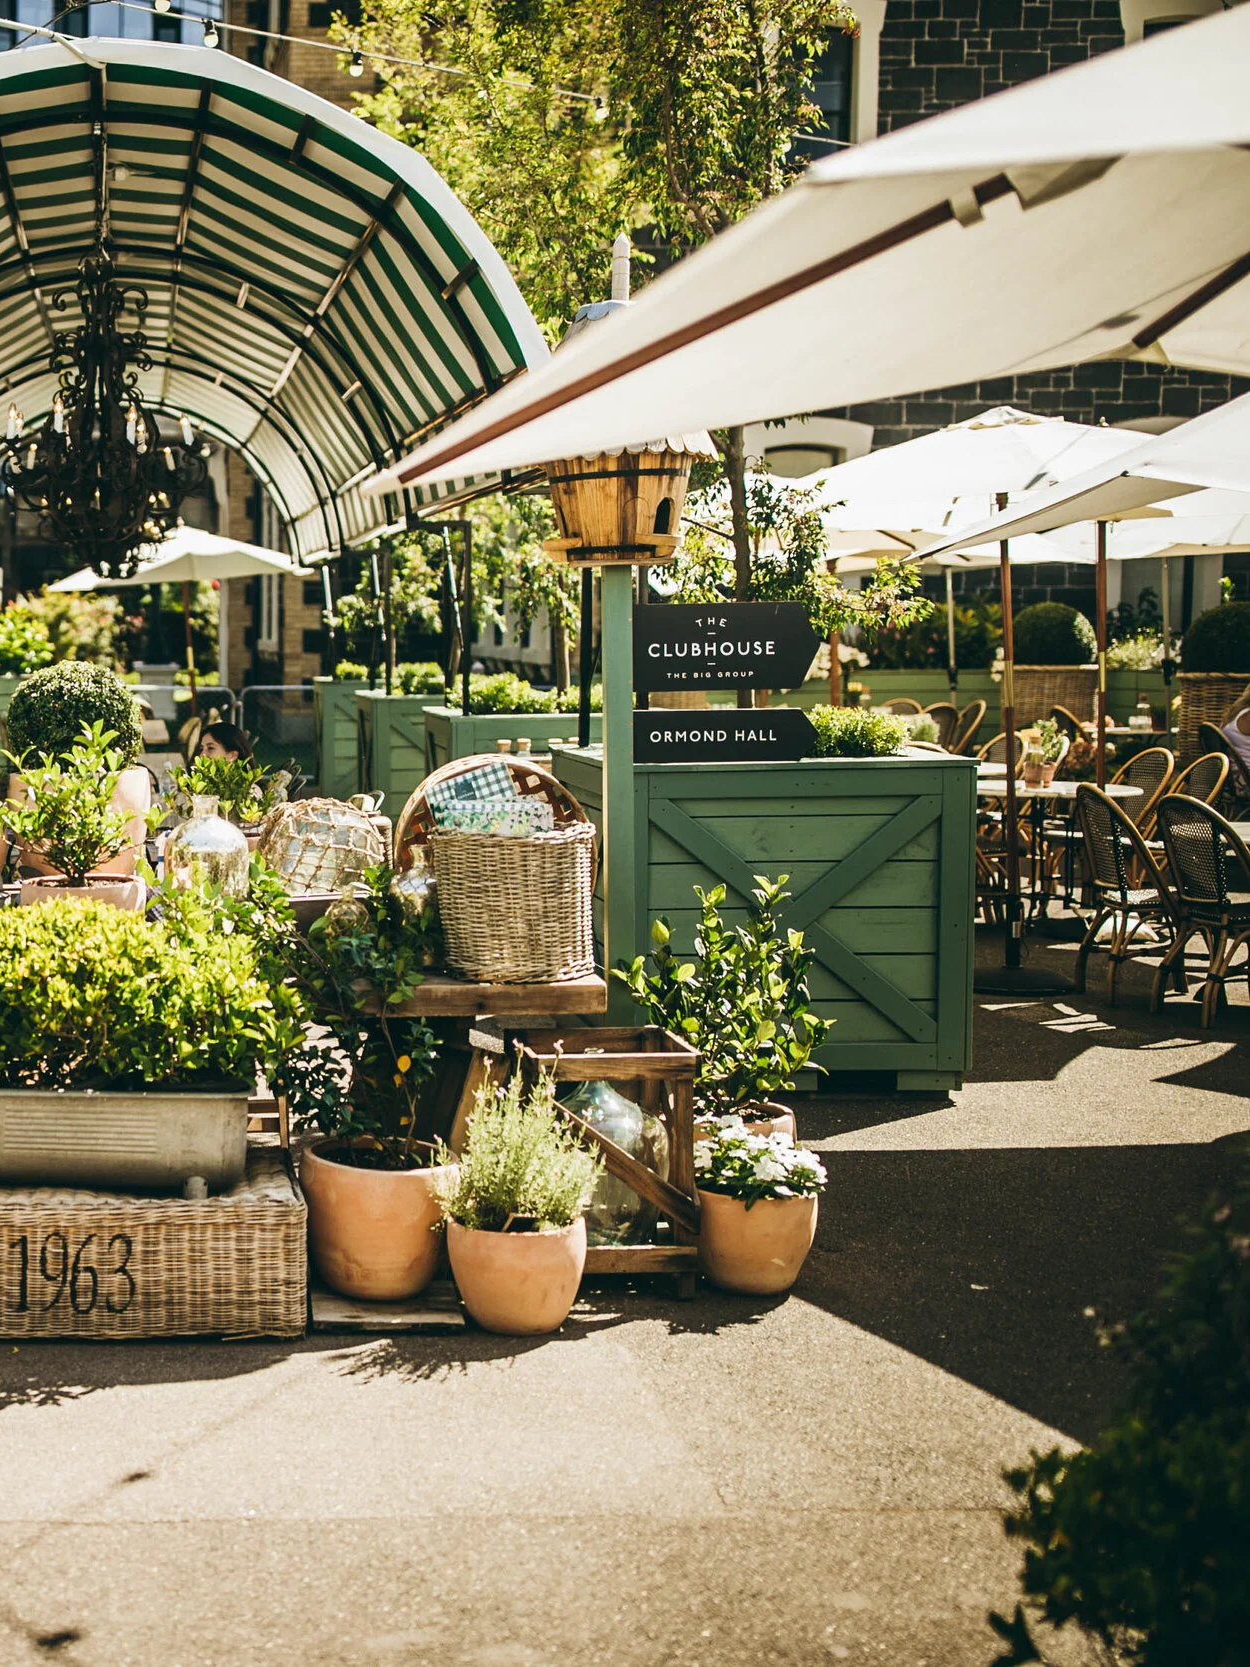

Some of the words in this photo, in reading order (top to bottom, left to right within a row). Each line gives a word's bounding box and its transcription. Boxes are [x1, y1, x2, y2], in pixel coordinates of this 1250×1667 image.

[695, 617, 728, 627] THE
[648, 641, 776, 658] CLUBHOUSE
[650, 730, 727, 743] ORMOND
[735, 729, 777, 742] HALL
[8, 1231, 136, 1315] 1963
